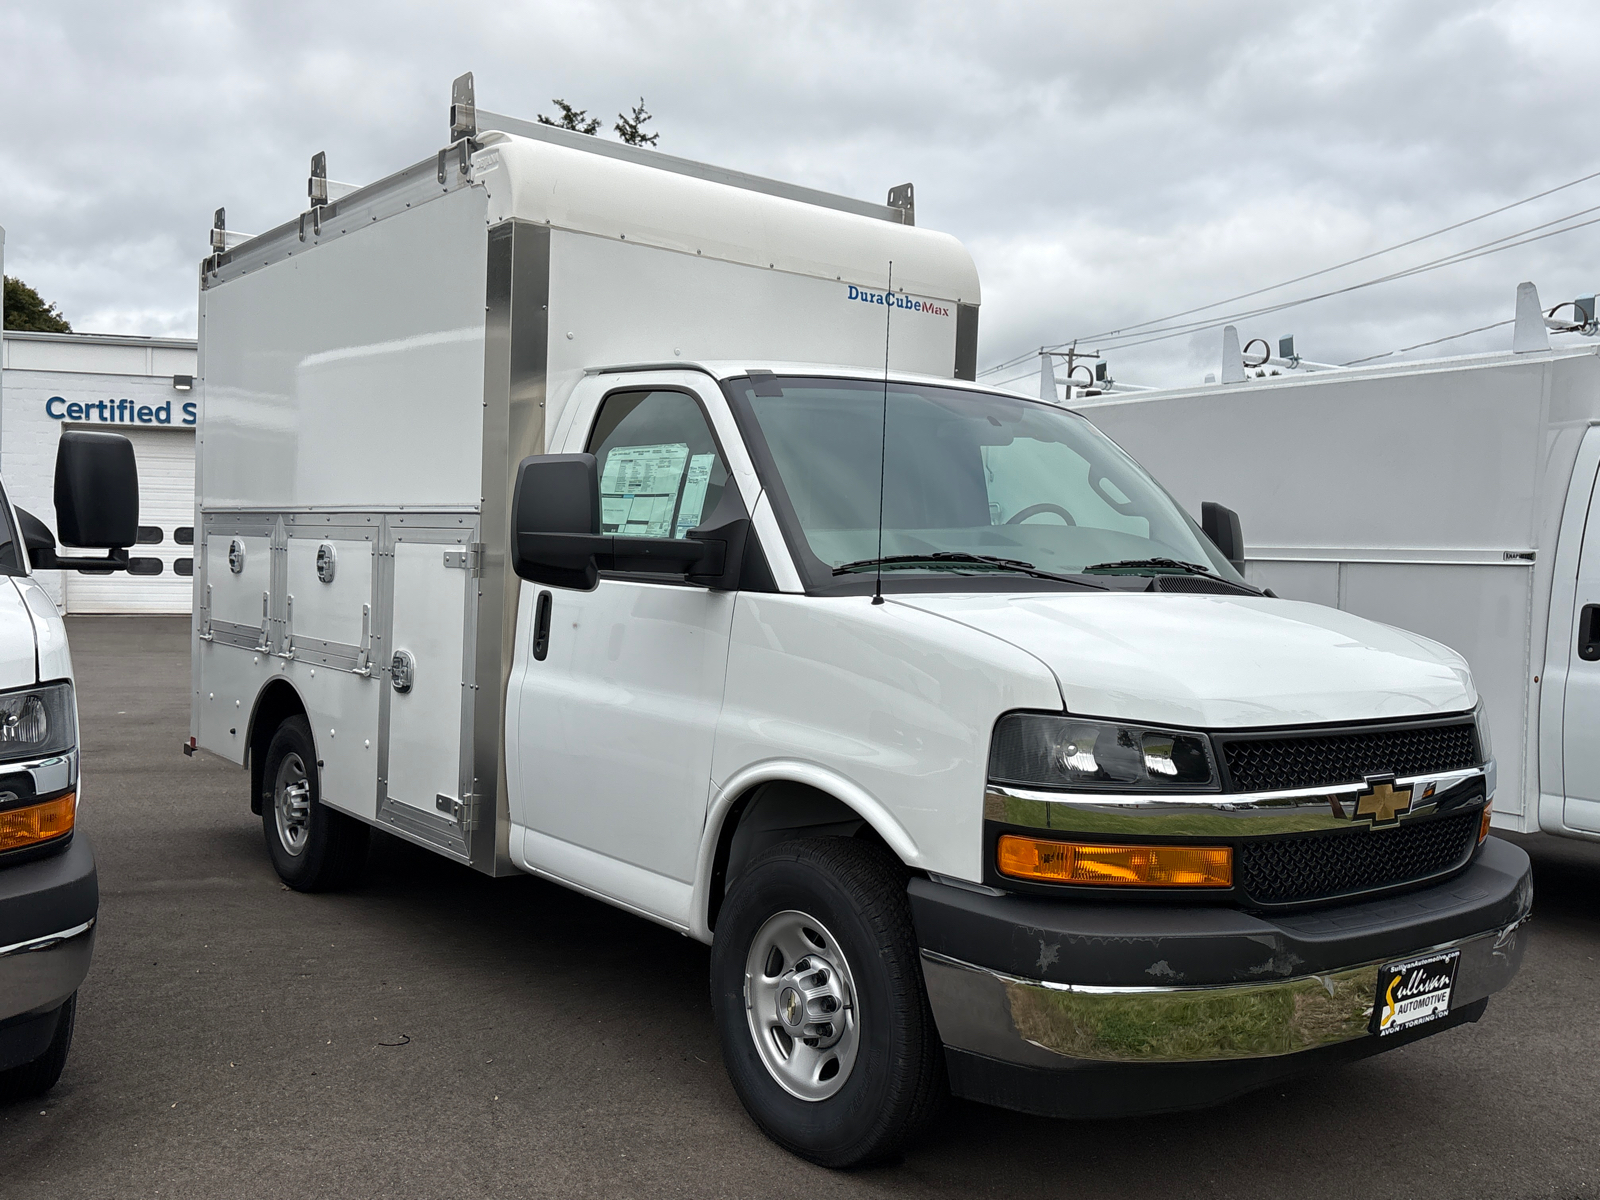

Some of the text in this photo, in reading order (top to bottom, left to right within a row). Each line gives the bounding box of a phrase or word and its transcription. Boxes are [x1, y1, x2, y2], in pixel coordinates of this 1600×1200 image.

[848, 285, 950, 317] DuraCubeMax
[45, 396, 171, 424] Certified
[1381, 968, 1450, 1026] Sullivan
[1397, 991, 1447, 1016] AUTOMOTIVE
[1380, 1025, 1400, 1037] AVON
